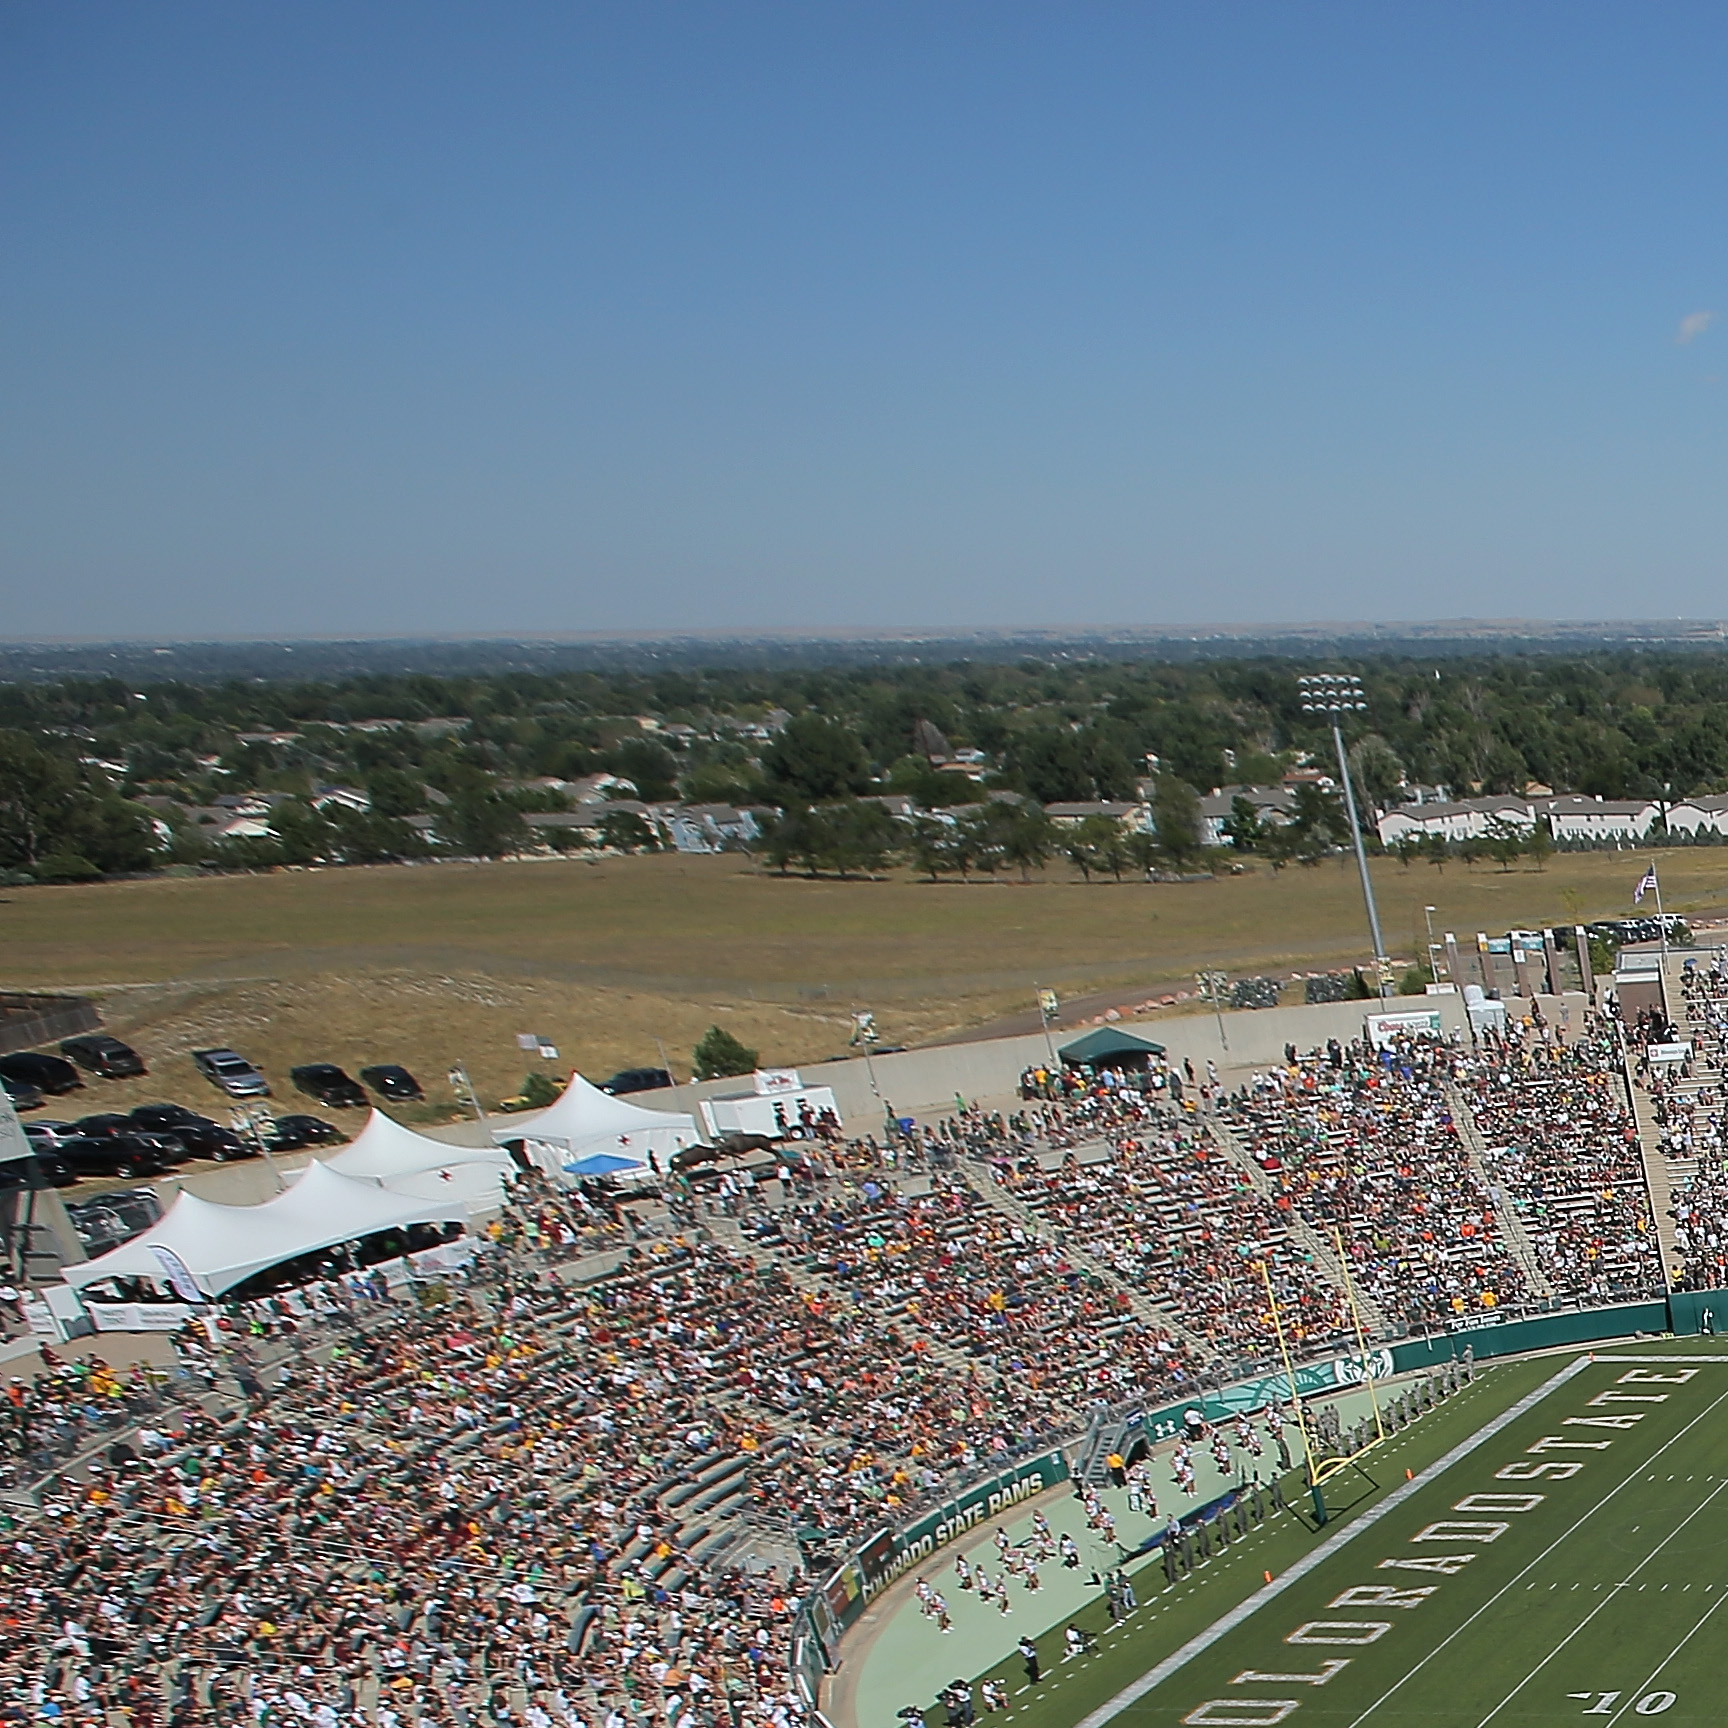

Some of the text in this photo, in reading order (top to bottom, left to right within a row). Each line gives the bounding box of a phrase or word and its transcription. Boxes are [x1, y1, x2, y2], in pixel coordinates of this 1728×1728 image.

[861, 1534, 933, 1604] COLORADO
[935, 1501, 985, 1546] STATE
[988, 1472, 1043, 1516] RAMS
[1582, 1690, 1678, 1716] 10
